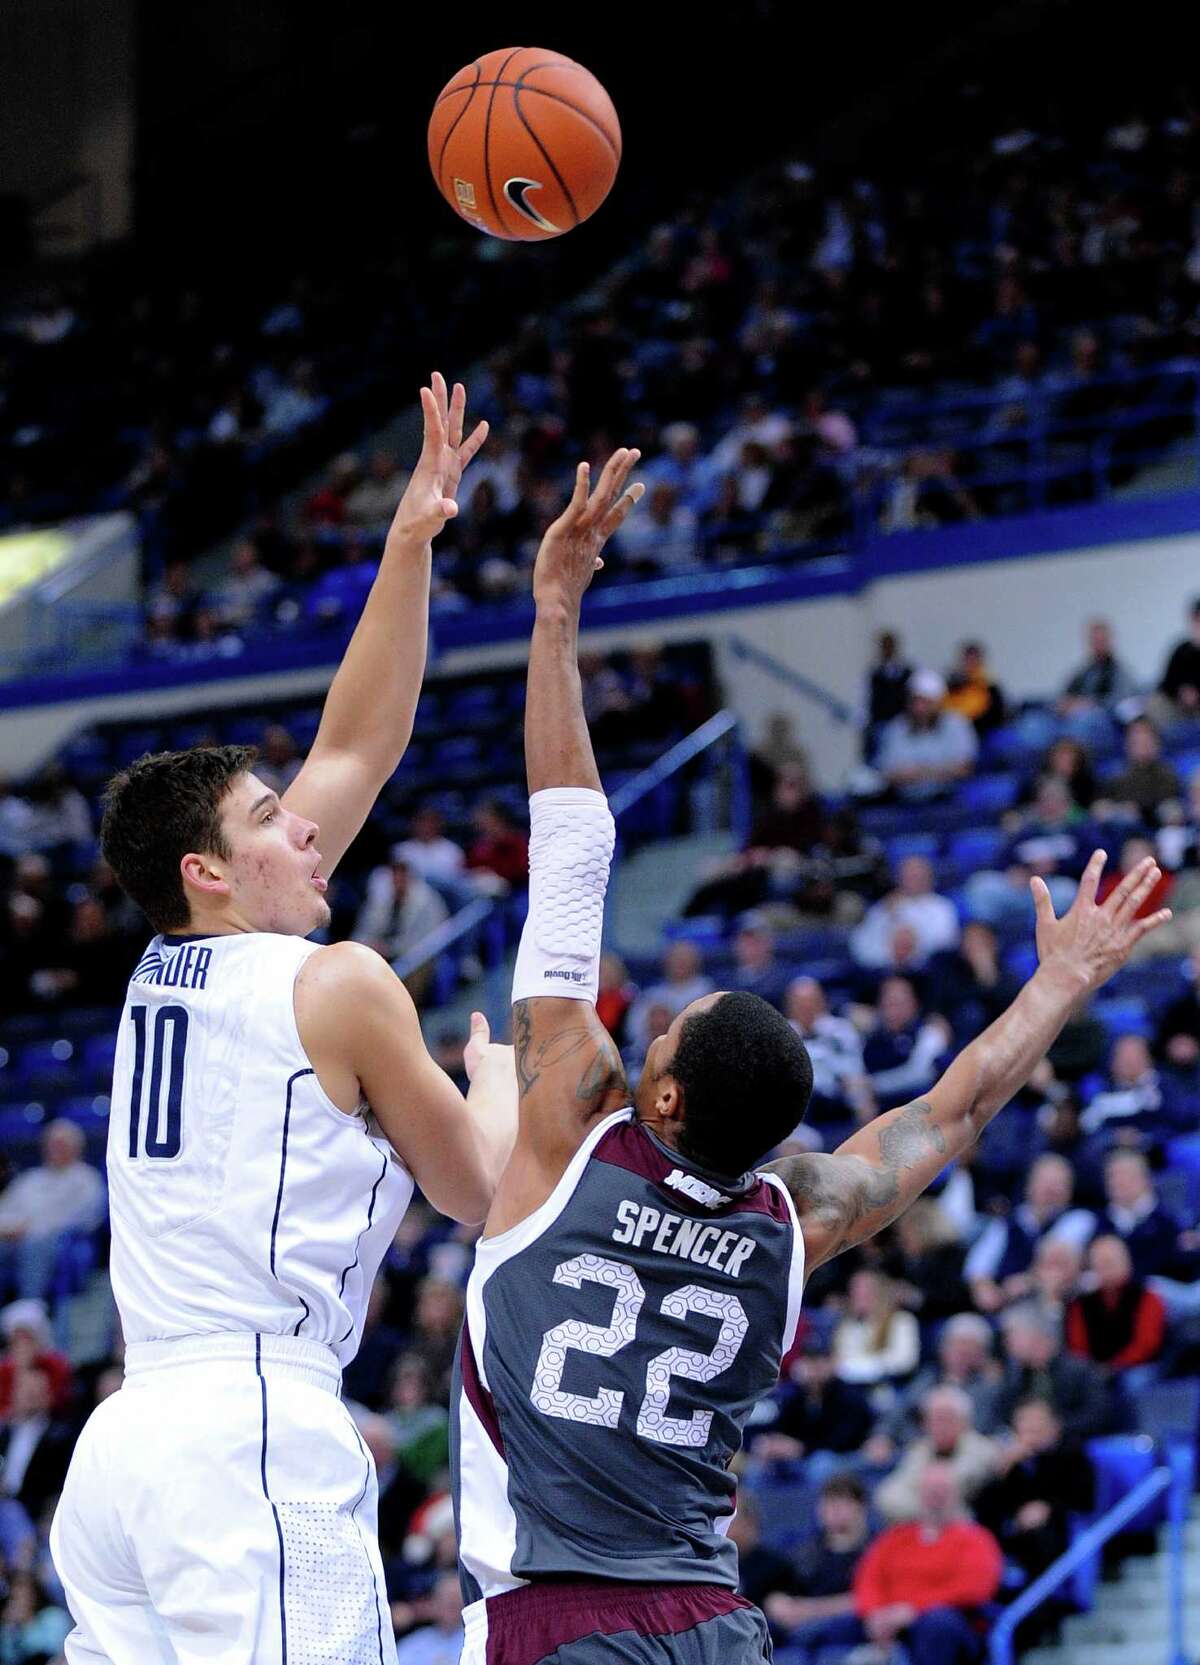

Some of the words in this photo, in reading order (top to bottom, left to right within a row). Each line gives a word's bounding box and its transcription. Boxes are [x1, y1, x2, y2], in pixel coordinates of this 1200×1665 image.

[129, 1005, 189, 1158] 10
[612, 1200, 756, 1278] SPENCER
[530, 1253, 749, 1447] 22
